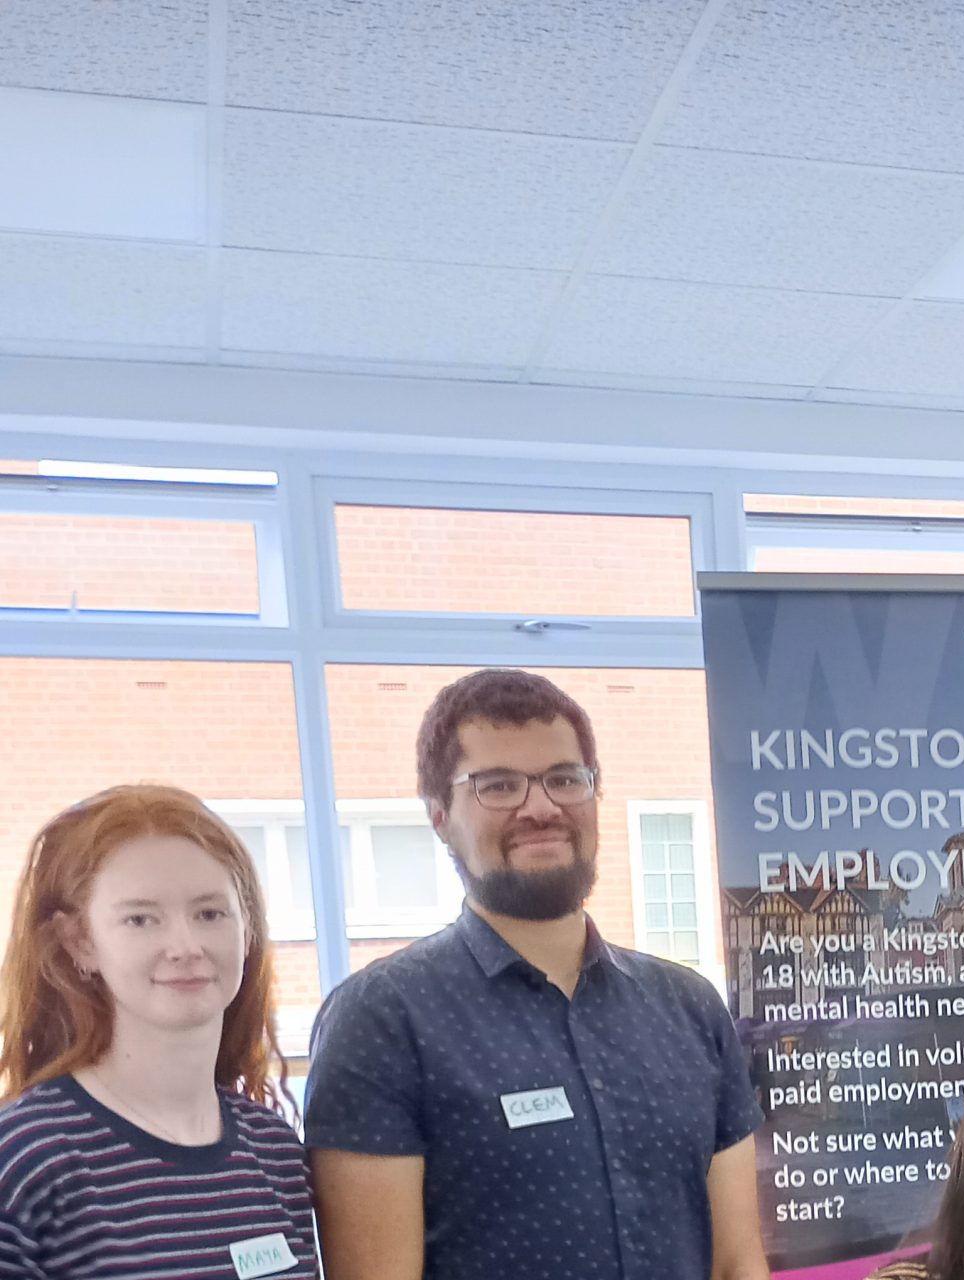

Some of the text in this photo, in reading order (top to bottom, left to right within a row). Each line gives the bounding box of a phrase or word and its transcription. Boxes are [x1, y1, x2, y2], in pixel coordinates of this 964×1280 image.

[759, 930, 804, 956] Are
[809, 933, 856, 958] you
[862, 933, 876, 952] a
[762, 964, 795, 989] 18
[800, 961, 855, 987] with
[860, 961, 953, 987] Autism,
[764, 995, 849, 1023] mental
[855, 993, 930, 1020] health
[767, 1043, 891, 1073] Interested
[897, 1042, 920, 1068] in
[509, 1094, 565, 1117] CLEM
[769, 1079, 821, 1110] paid
[772, 1130, 820, 1156] Not
[825, 1132, 877, 1153] sure
[882, 1125, 944, 1150] what
[774, 1159, 951, 1189] do or where to
[775, 1195, 846, 1222] start?
[238, 1247, 282, 1274] MAYA
